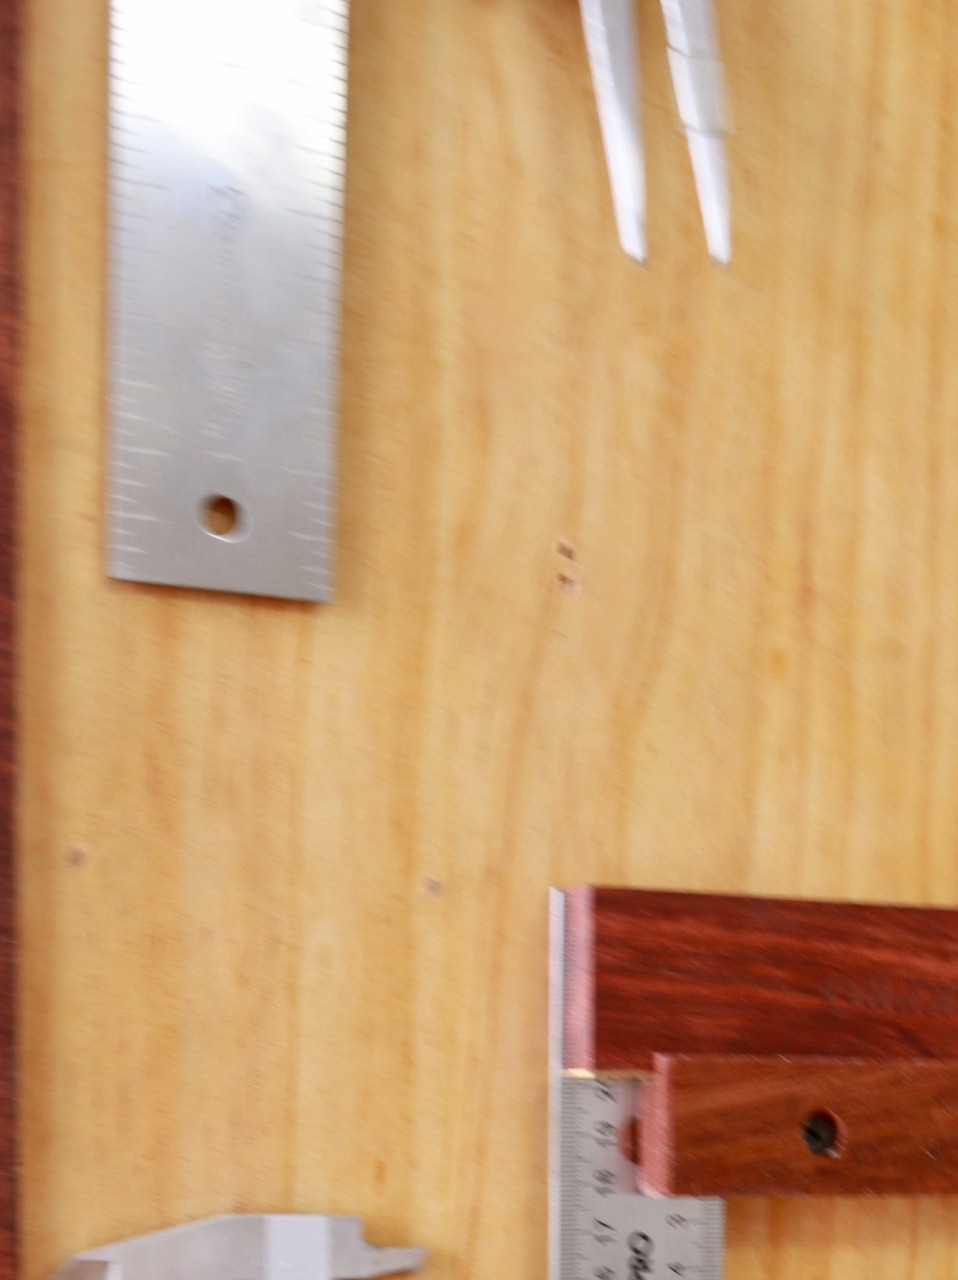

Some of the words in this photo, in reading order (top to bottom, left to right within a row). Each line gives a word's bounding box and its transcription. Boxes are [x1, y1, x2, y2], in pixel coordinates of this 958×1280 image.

[593, 1121, 615, 1149] 19
[593, 1170, 615, 1197] 18
[593, 1218, 615, 1245] 17
